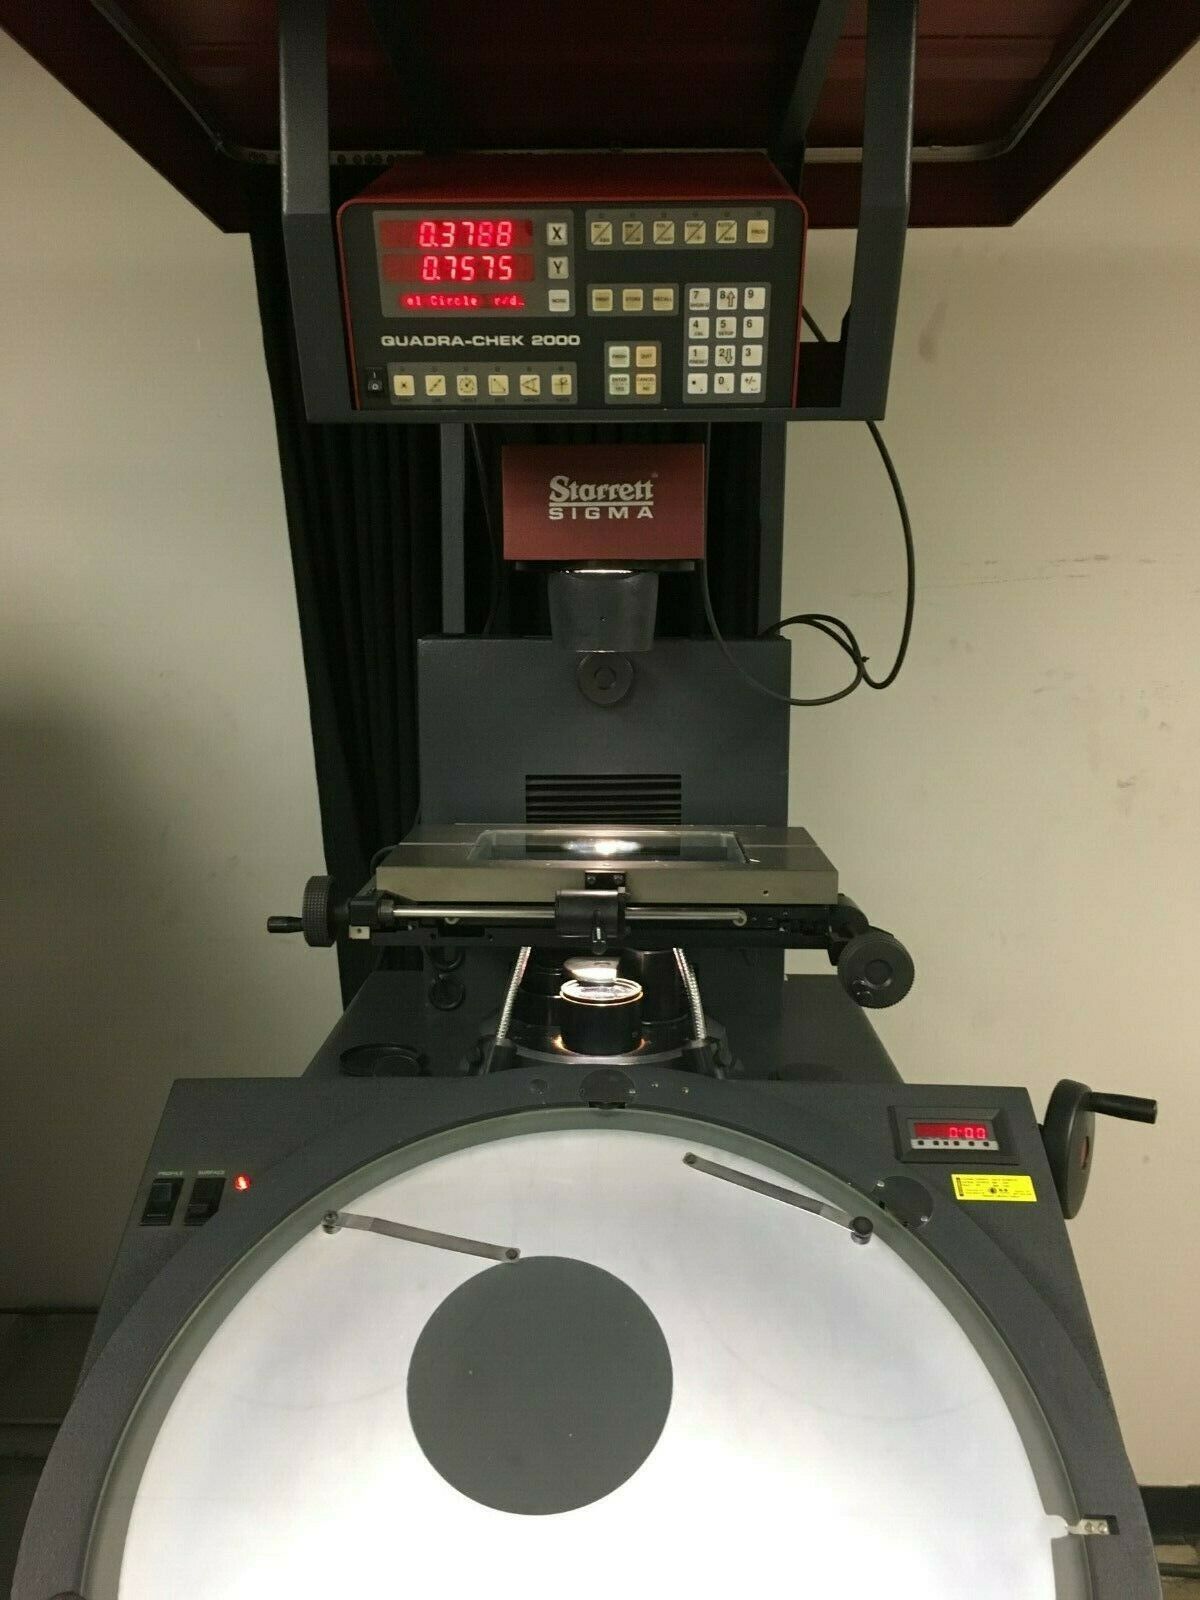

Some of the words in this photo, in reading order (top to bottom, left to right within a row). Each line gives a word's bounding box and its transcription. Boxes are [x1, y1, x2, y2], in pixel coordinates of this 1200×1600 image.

[552, 227, 562, 240] X
[422, 256, 513, 281] 0.7575
[553, 261, 563, 274] Y
[693, 290, 700, 299] 7
[719, 290, 726, 299] 8
[748, 290, 754, 299] 9
[430, 295, 478, 306] Circle
[693, 320, 699, 328] 4
[720, 320, 726, 328] 5
[746, 319, 753, 328] 6
[380, 335, 524, 347] QUADRA-CHEK
[531, 334, 581, 346] 2000
[692, 349, 698, 357] 1
[719, 348, 725, 357] 2
[745, 348, 752, 357] 3
[718, 376, 725, 385] 0
[549, 475, 655, 502] Starrett
[549, 506, 654, 520] SIGMA
